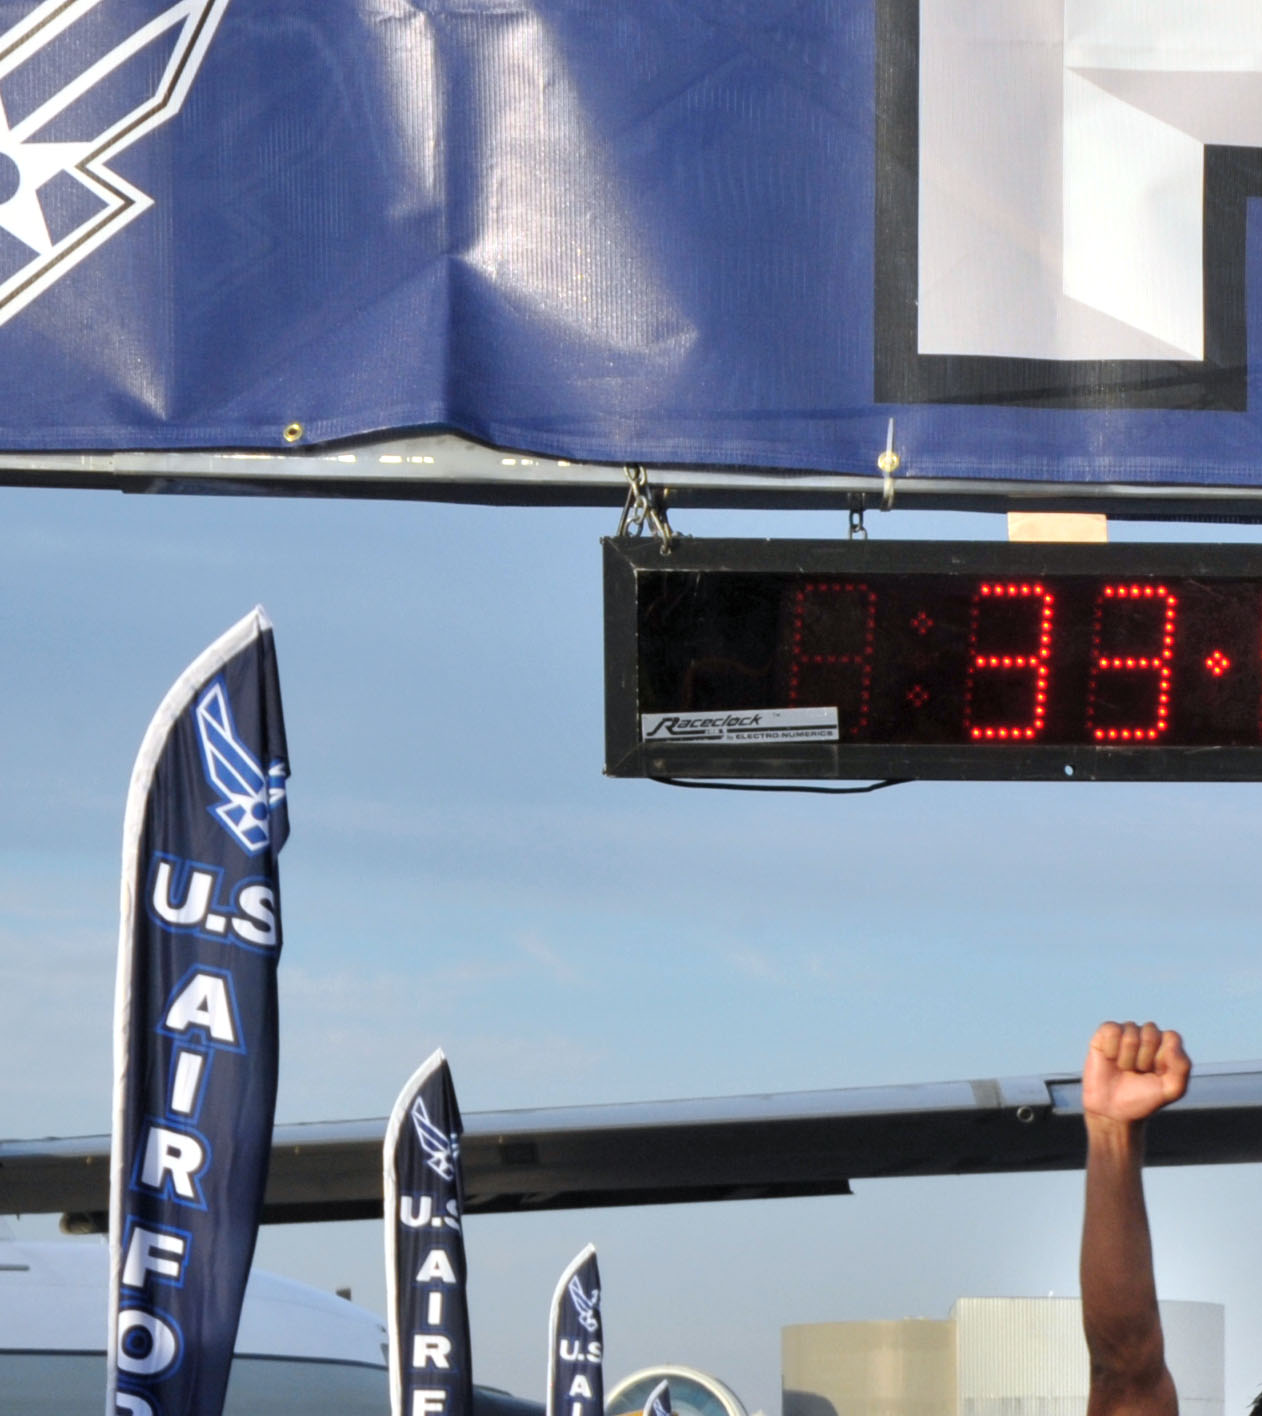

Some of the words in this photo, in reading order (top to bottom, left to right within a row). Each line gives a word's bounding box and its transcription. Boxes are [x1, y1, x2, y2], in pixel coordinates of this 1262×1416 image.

[646, 713, 763, 737] Raceclock
[141, 973, 236, 1198] AIR
[411, 1249, 457, 1369] AIR
